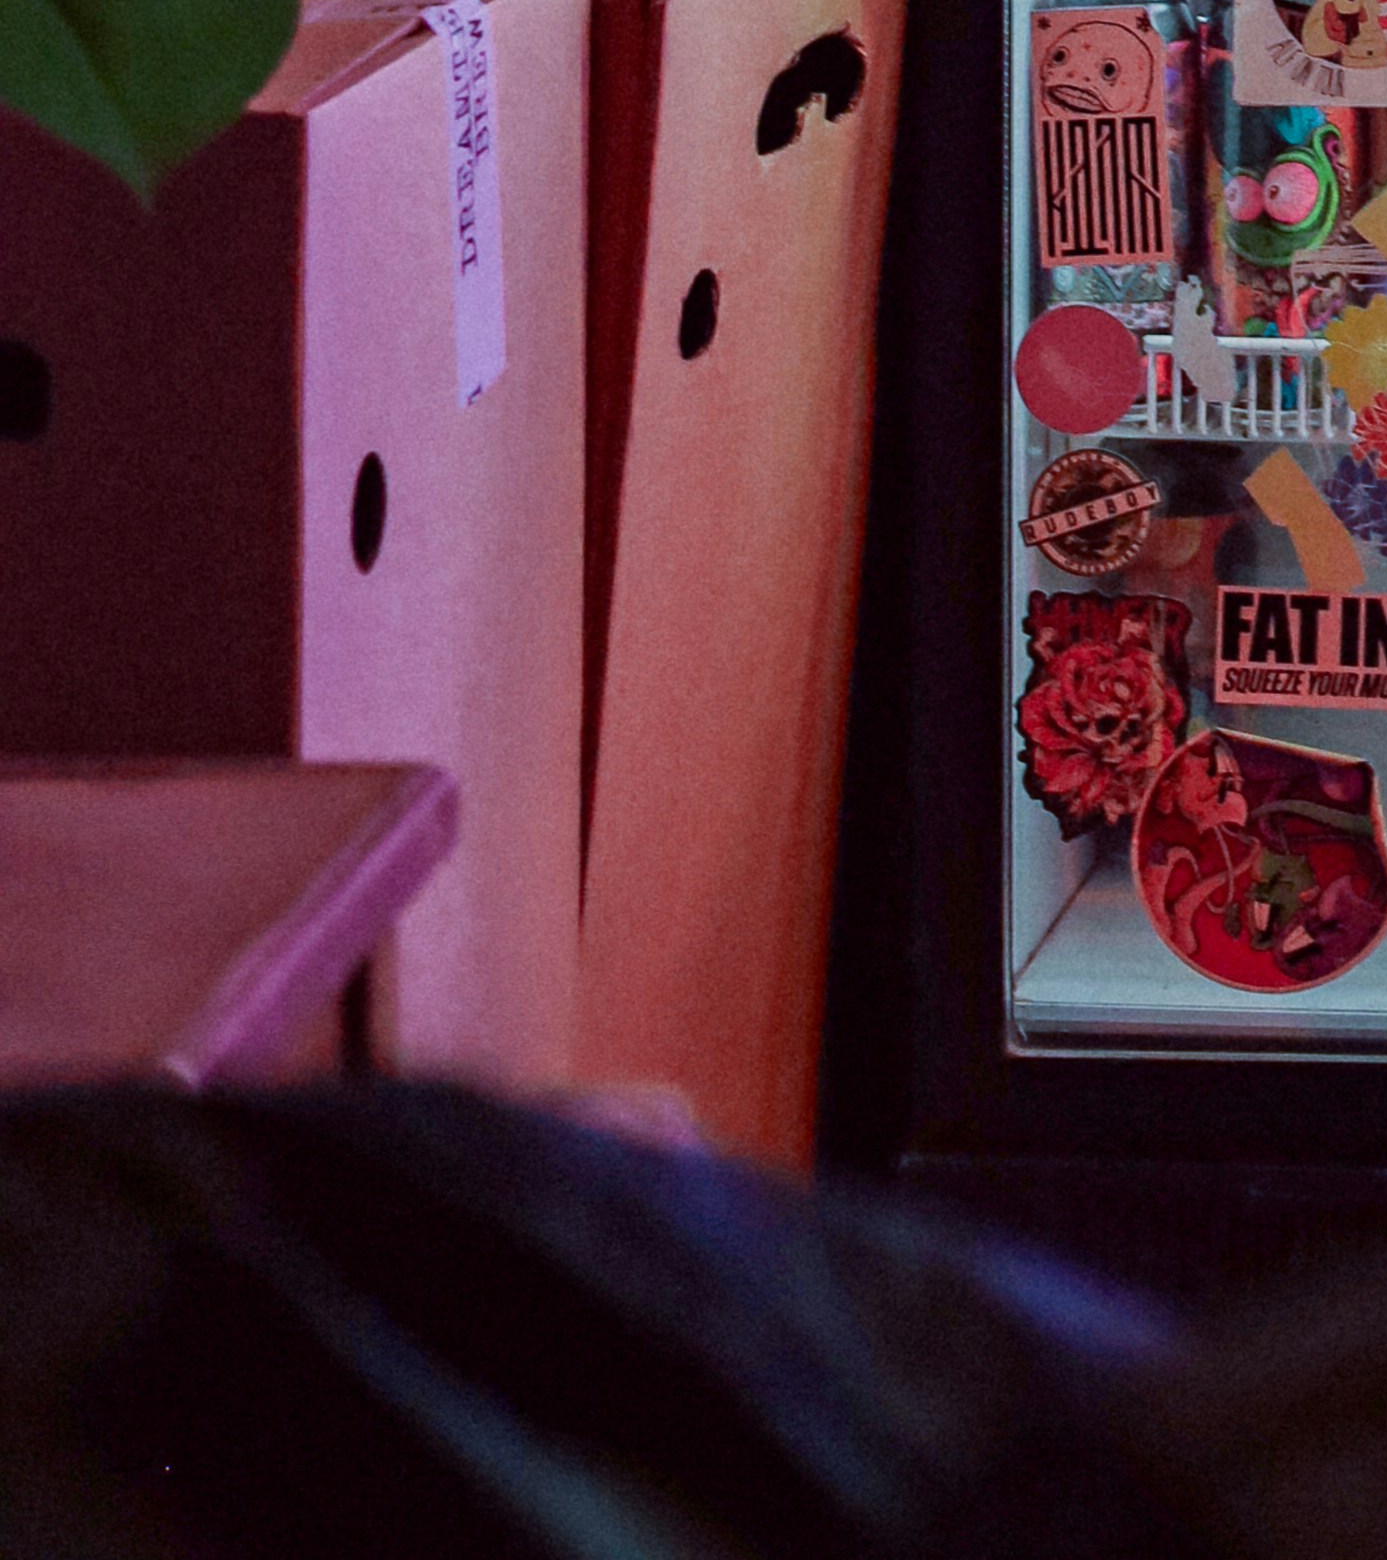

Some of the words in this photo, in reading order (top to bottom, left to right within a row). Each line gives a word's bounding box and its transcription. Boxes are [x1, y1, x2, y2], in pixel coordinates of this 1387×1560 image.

[1025, 483, 1158, 542] RUDEBOY
[1220, 591, 1331, 666] FAT
[1221, 667, 1303, 696] SQUEEZE
[1307, 670, 1359, 699] YOUR
